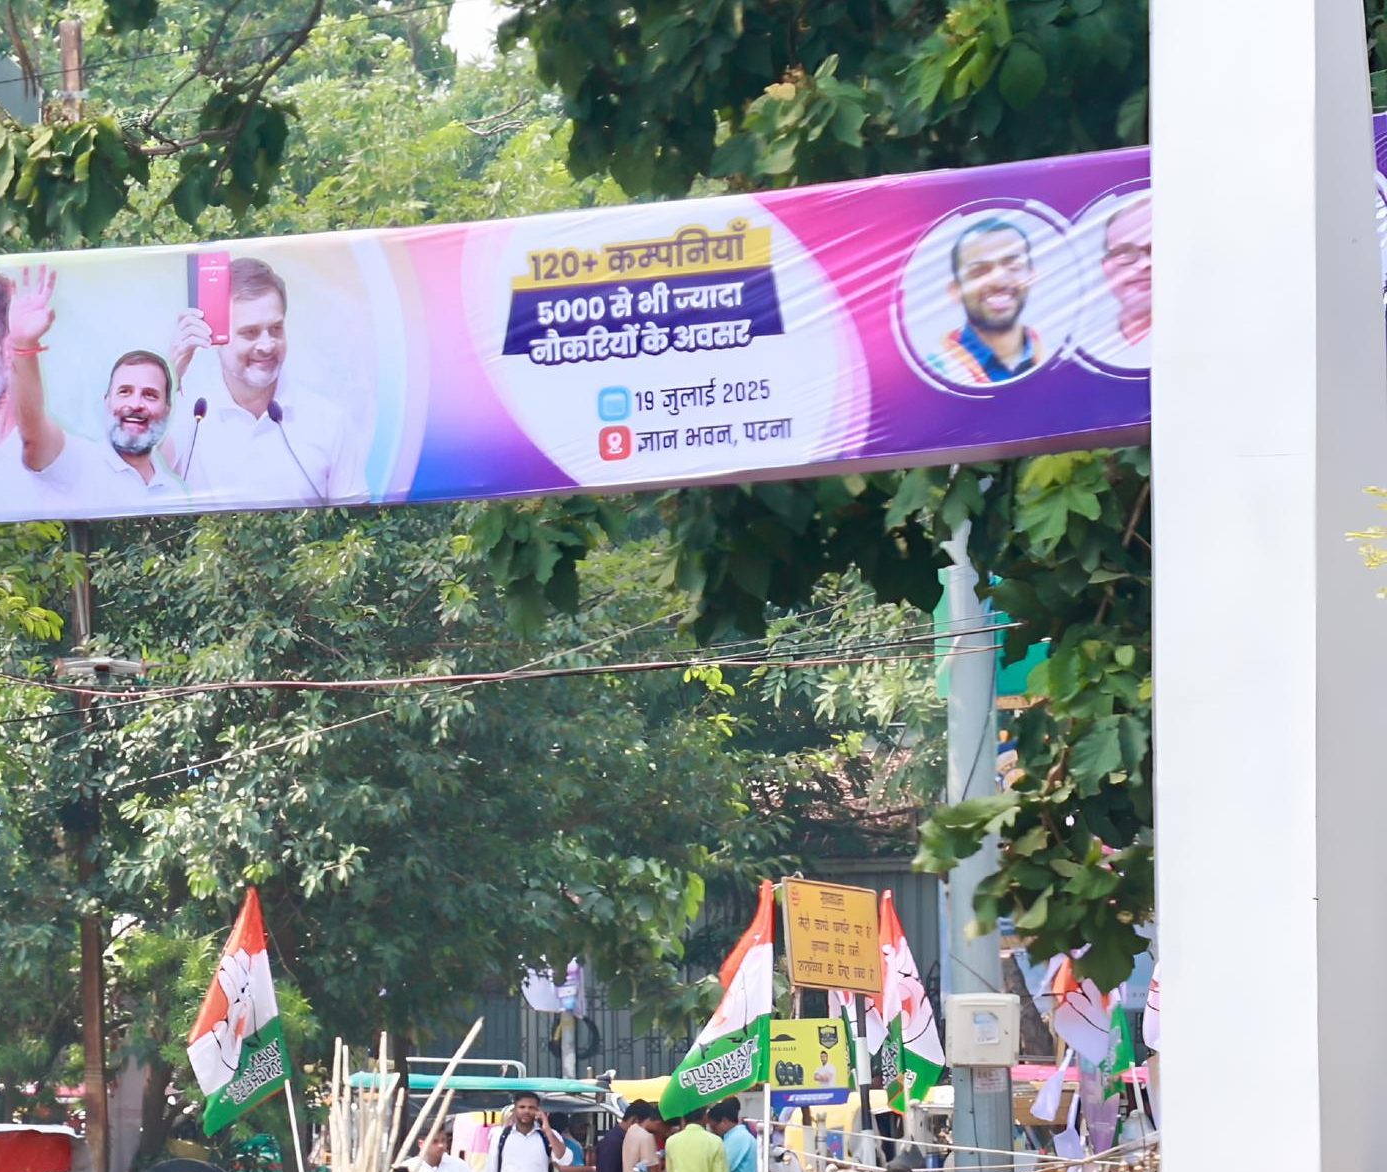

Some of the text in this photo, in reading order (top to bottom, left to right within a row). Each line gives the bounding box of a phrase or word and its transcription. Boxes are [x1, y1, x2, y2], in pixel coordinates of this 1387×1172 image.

[531, 220, 746, 281] 120+ कम्पनियाँ
[537, 281, 745, 325] 5000 से भी ज्यादा
[529, 319, 752, 362] नौकरियों के अवसर
[635, 378, 771, 416] 19 जुलाई 2025
[636, 417, 793, 453] ज्ञान भवन, पटना
